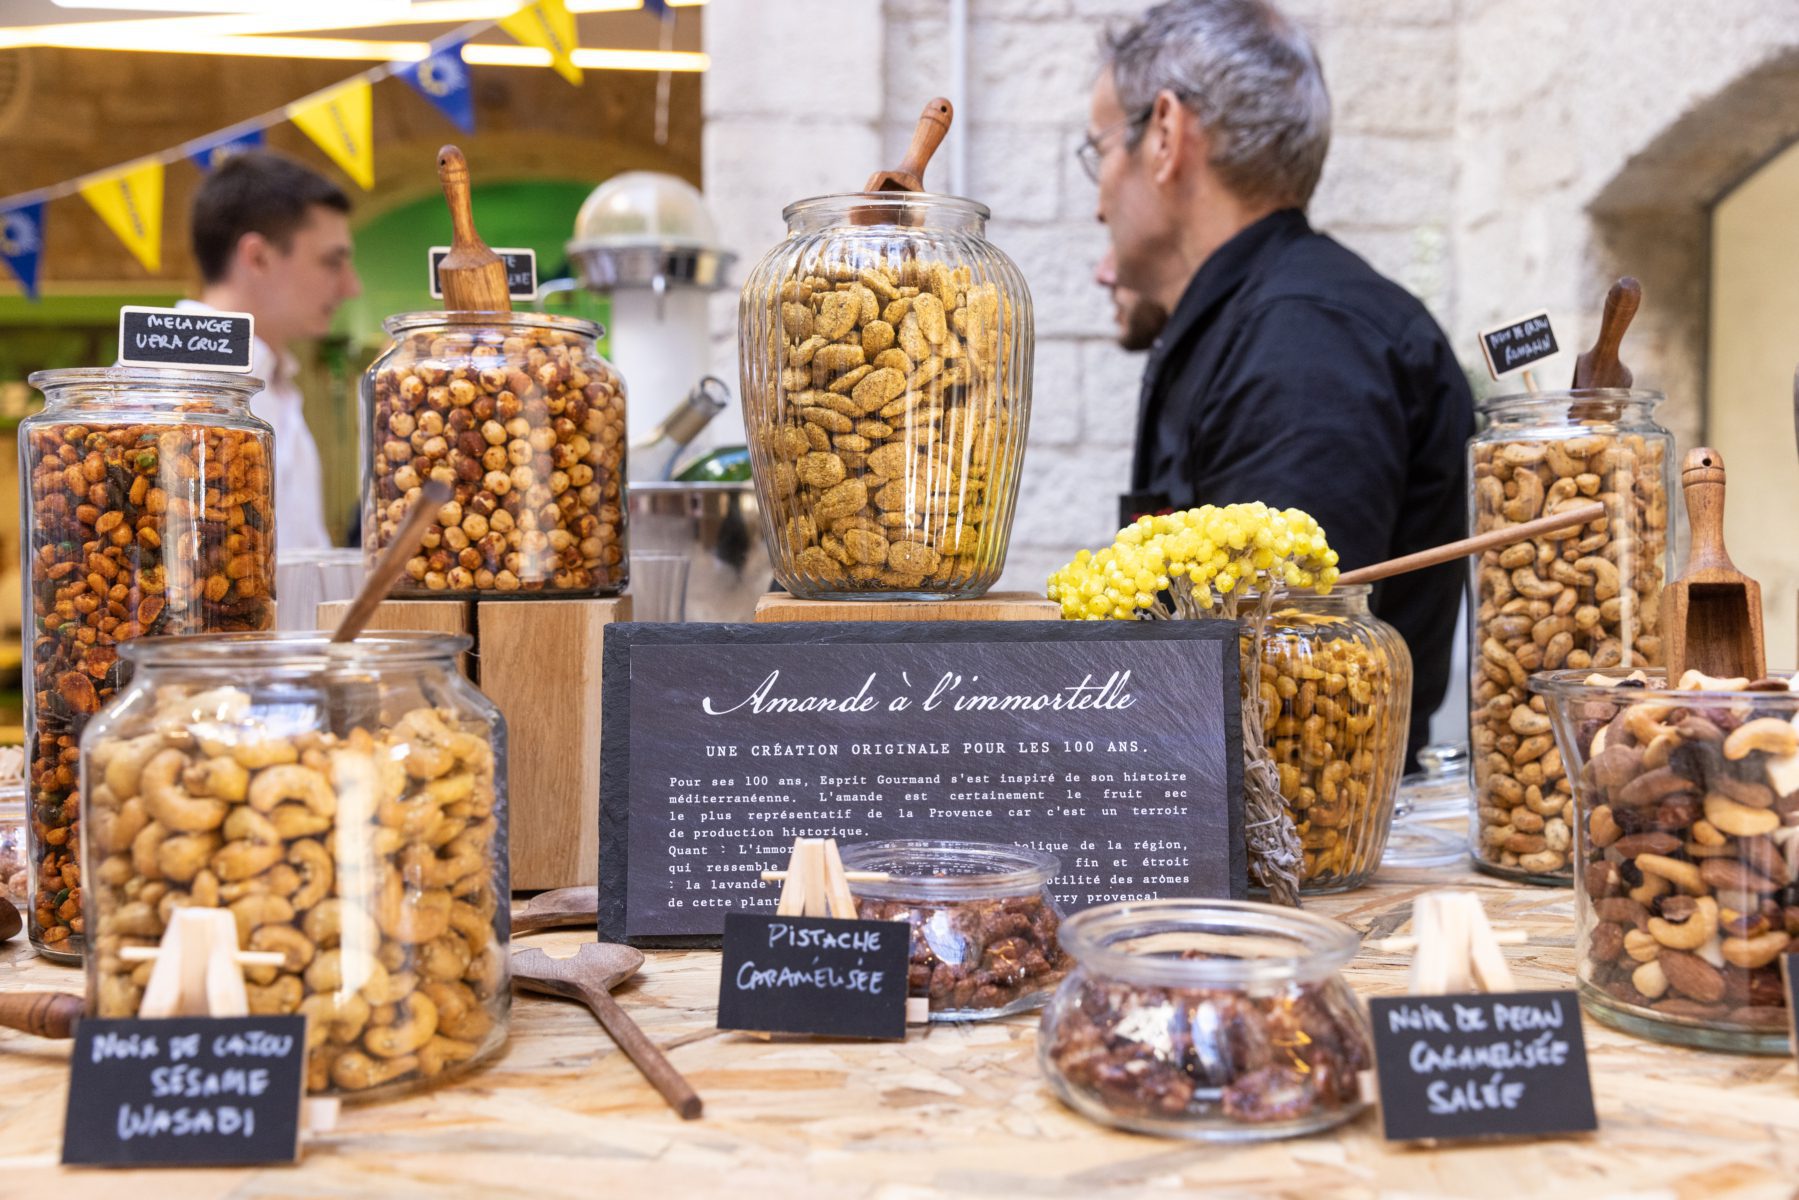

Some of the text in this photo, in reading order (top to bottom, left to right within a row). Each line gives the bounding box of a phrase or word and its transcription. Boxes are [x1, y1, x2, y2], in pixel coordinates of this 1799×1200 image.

[147, 314, 233, 333] MELANGE
[136, 333, 233, 354] VERA CRUZ
[702, 669, 1136, 716] Amande à l'immortelle
[706, 740, 1148, 758] UNE CRÉATION ORIGINALE POUR LES 100 ANS.
[670, 771, 1187, 790] Pour ses 100 ans, Esprit Gourmand s'est inspiré de son histoire
[669, 788, 1187, 805] méditerranéenne. L'amande est certainement le fruit sec
[670, 805, 1188, 823] le plus représentatif de la Provence car c'est un terroir
[669, 826, 870, 840] de production historique.
[669, 845, 708, 858] Quant
[739, 842, 795, 855] L'immor
[1080, 840, 1096, 851] de
[1108, 839, 1123, 850] la
[1134, 839, 1189, 853] région,
[669, 856, 1189, 876] qui ressemble fin et étroit
[686, 879, 701, 890] la
[711, 878, 767, 890] lavande
[1110, 874, 1133, 885] des
[1143, 874, 1190, 884] arômes
[668, 897, 684, 908] de
[693, 898, 732, 908] cette
[740, 895, 781, 910] plant
[1055, 893, 1079, 905] rry
[1453, 1002, 1487, 1032] DE
[1493, 999, 1563, 1031] PECAN
[169, 1034, 200, 1061] DE
[212, 1030, 293, 1058] CAJOU
[1426, 1071, 1525, 1115] SALÉE
[117, 1103, 255, 1141] WASABI
